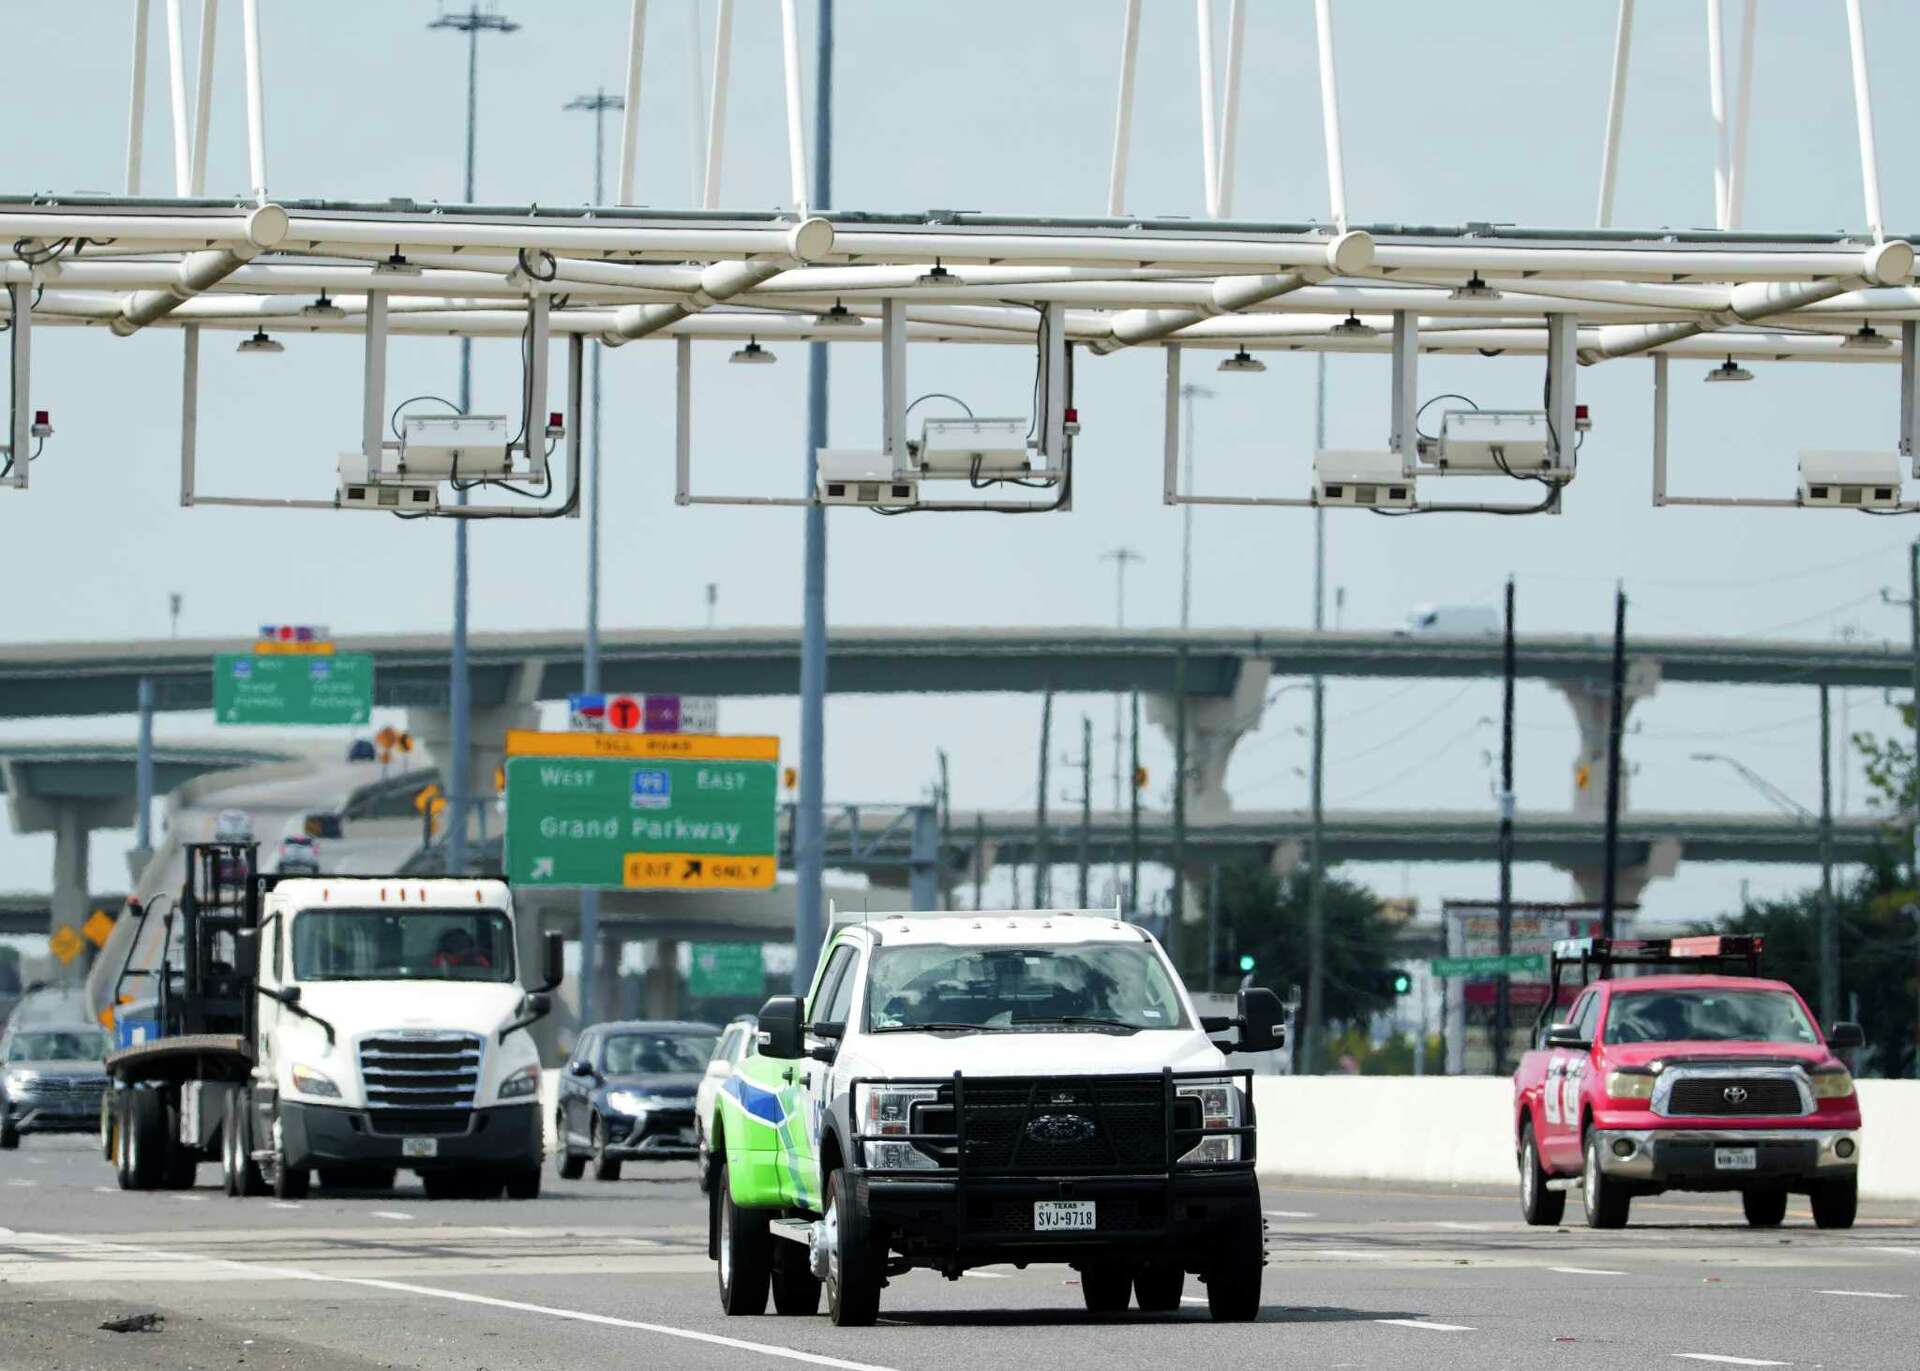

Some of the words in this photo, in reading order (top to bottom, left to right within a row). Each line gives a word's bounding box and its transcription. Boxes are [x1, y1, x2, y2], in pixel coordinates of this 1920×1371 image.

[540, 816, 619, 840] Grand
[632, 816, 741, 845] Parkway
[711, 864, 760, 878] ONLY
[1038, 1211, 1093, 1226] SVJ-9718
